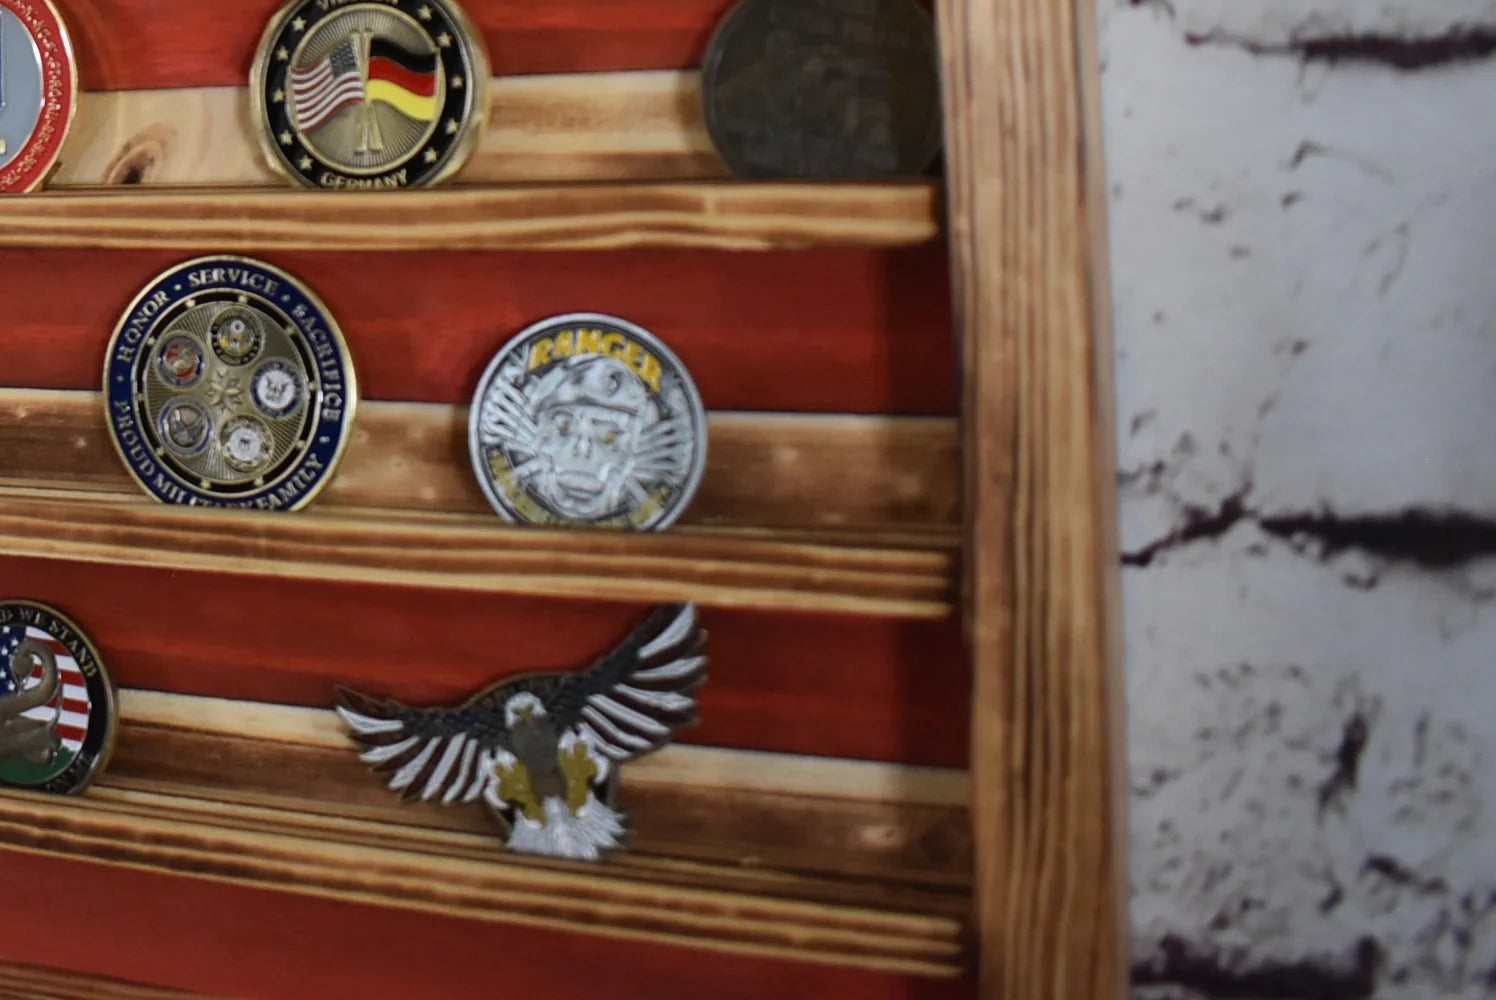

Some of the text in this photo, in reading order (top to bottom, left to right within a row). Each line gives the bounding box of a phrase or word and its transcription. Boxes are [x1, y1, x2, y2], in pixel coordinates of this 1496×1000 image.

[116, 267, 342, 421] HONOR SERVICE SACRIFICE
[527, 327, 663, 393] RANGER
[114, 399, 155, 477] PROUD
[255, 452, 324, 510] FAMILY
[48, 620, 99, 679] STAND
